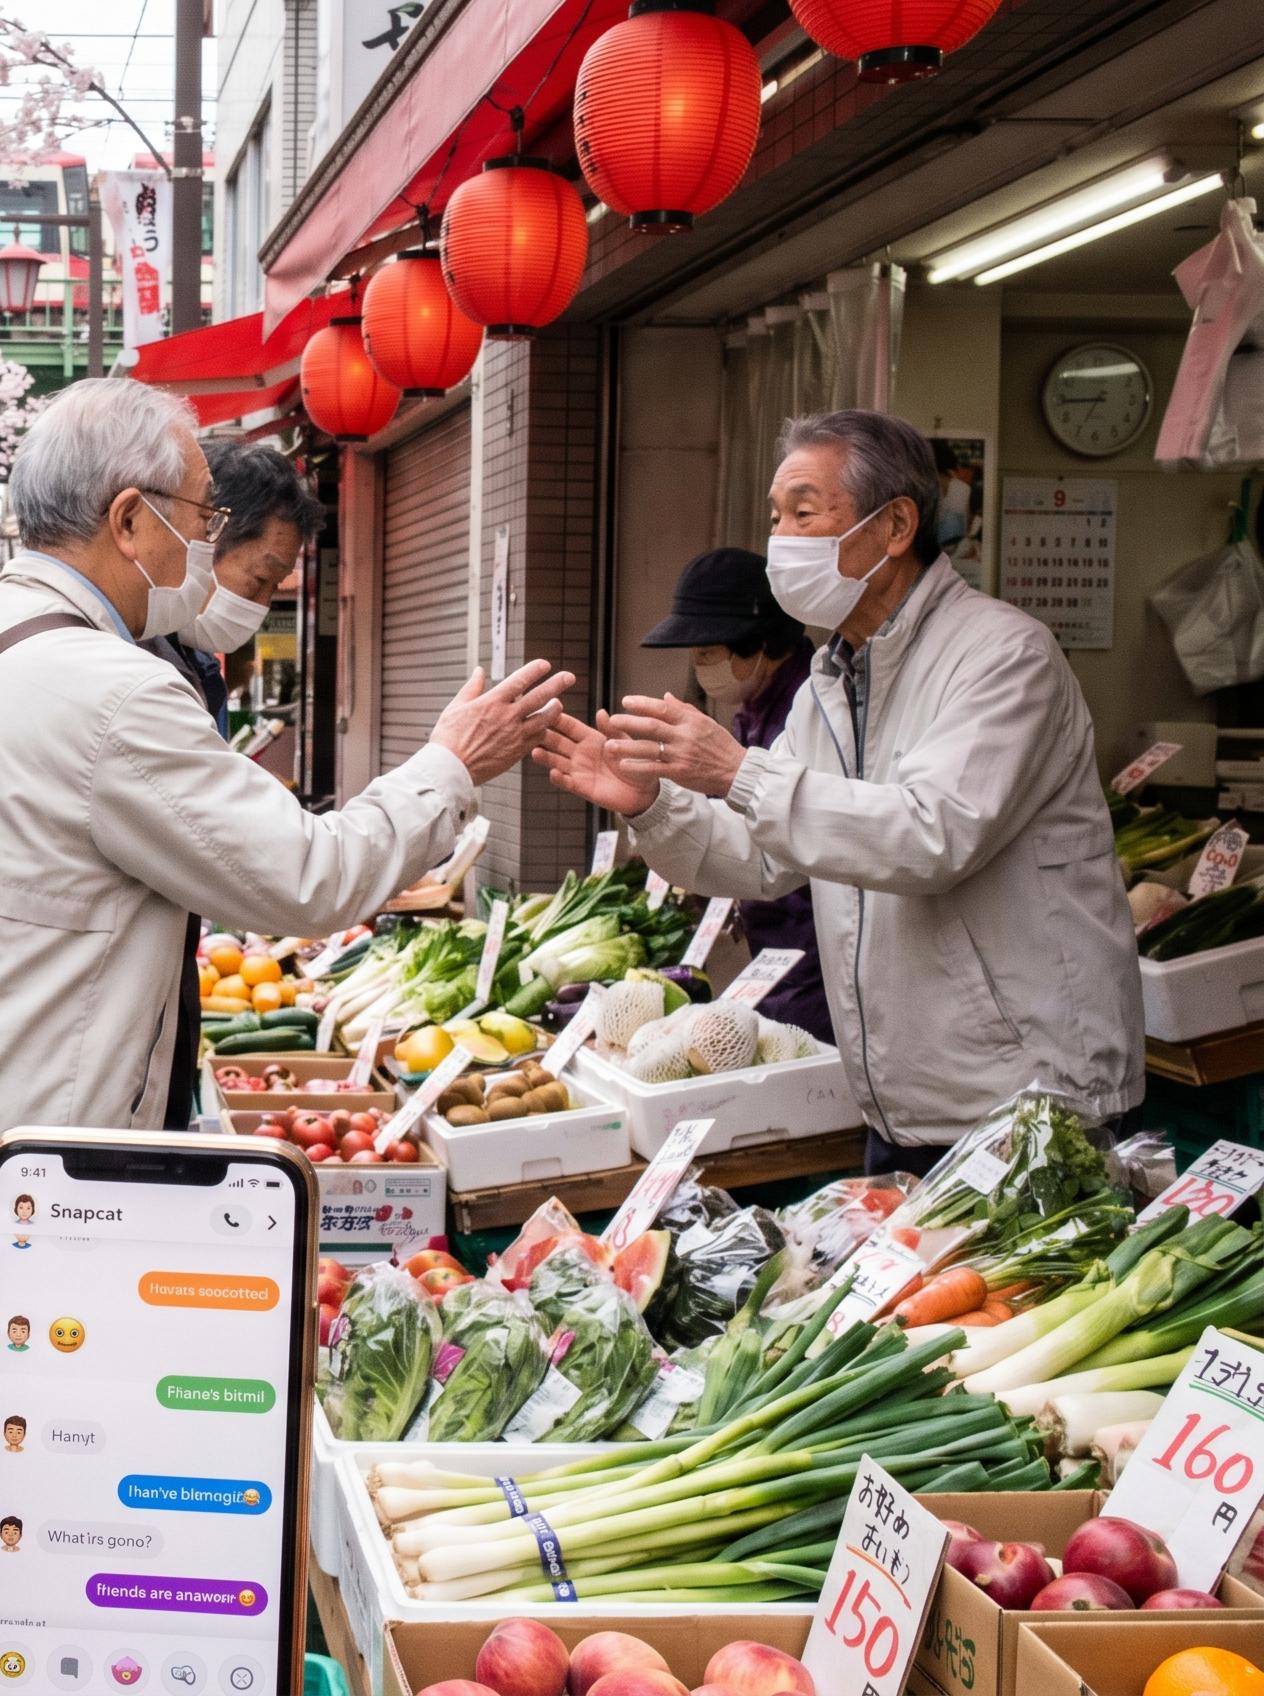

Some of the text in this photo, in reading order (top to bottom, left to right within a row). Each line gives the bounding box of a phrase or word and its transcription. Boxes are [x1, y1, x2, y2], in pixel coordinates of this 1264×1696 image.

[1053, 489, 1067, 508] 9
[20, 1167, 47, 1178] 9:41
[50, 1203, 124, 1224] Snapcat
[1152, 1413, 1254, 1495] 160
[1211, 1501, 1238, 1534] 円
[48, 1530, 85, 1544] What
[107, 1535, 152, 1549] gono?
[149, 1588, 173, 1600] are
[824, 1568, 899, 1678] 150
